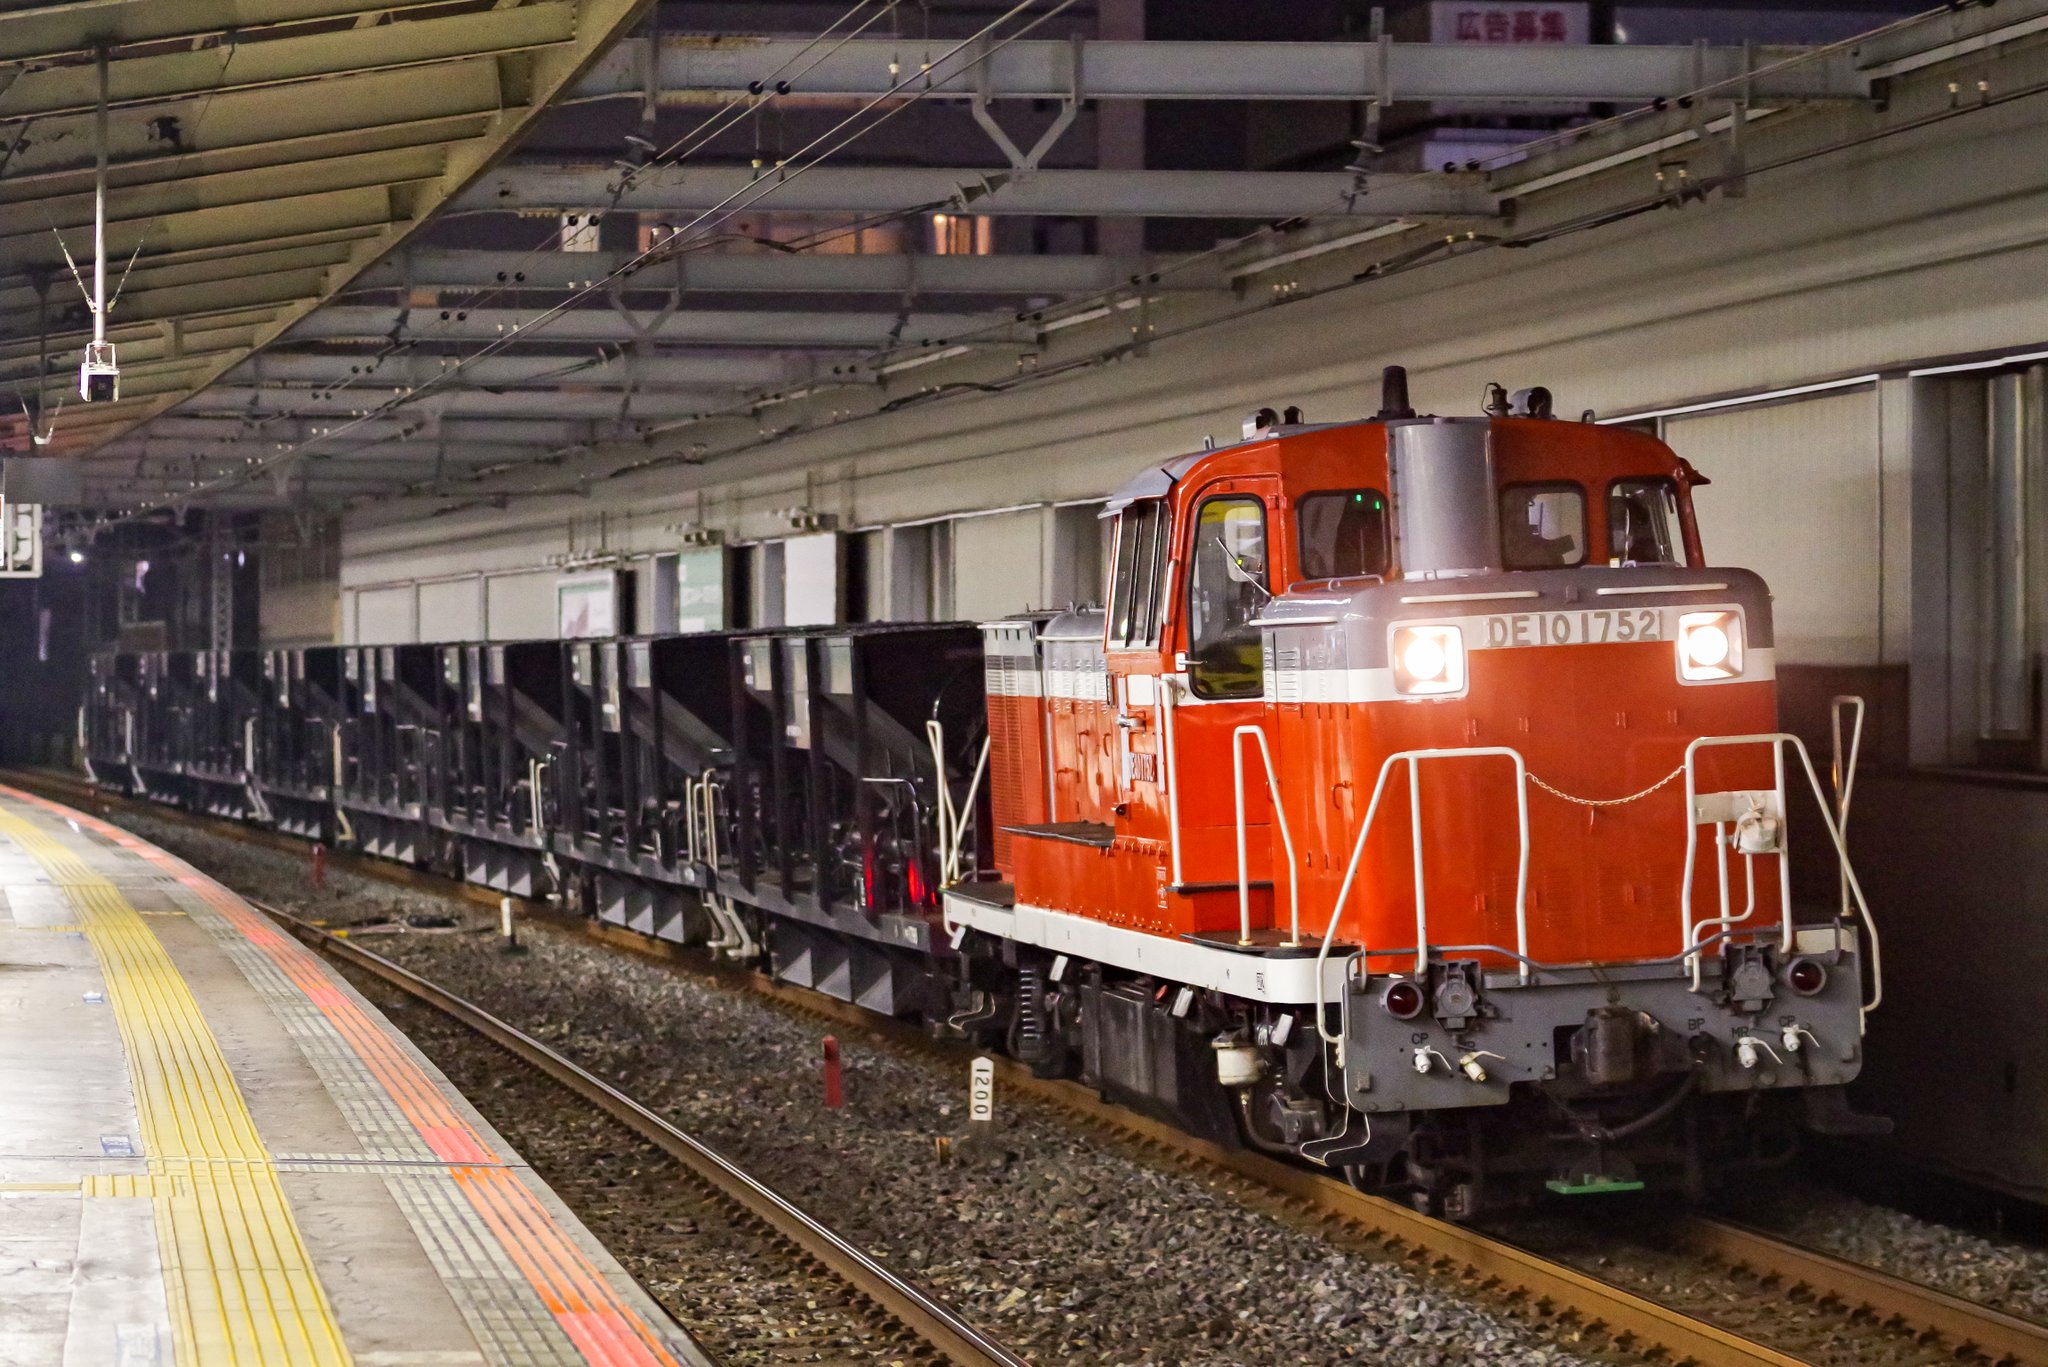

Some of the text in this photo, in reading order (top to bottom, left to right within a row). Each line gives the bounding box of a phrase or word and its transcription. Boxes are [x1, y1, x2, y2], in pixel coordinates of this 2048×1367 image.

[1687, 1017, 1706, 1031] BP
[1411, 1032, 1430, 1045] CP
[974, 1068, 990, 1114] 1200
